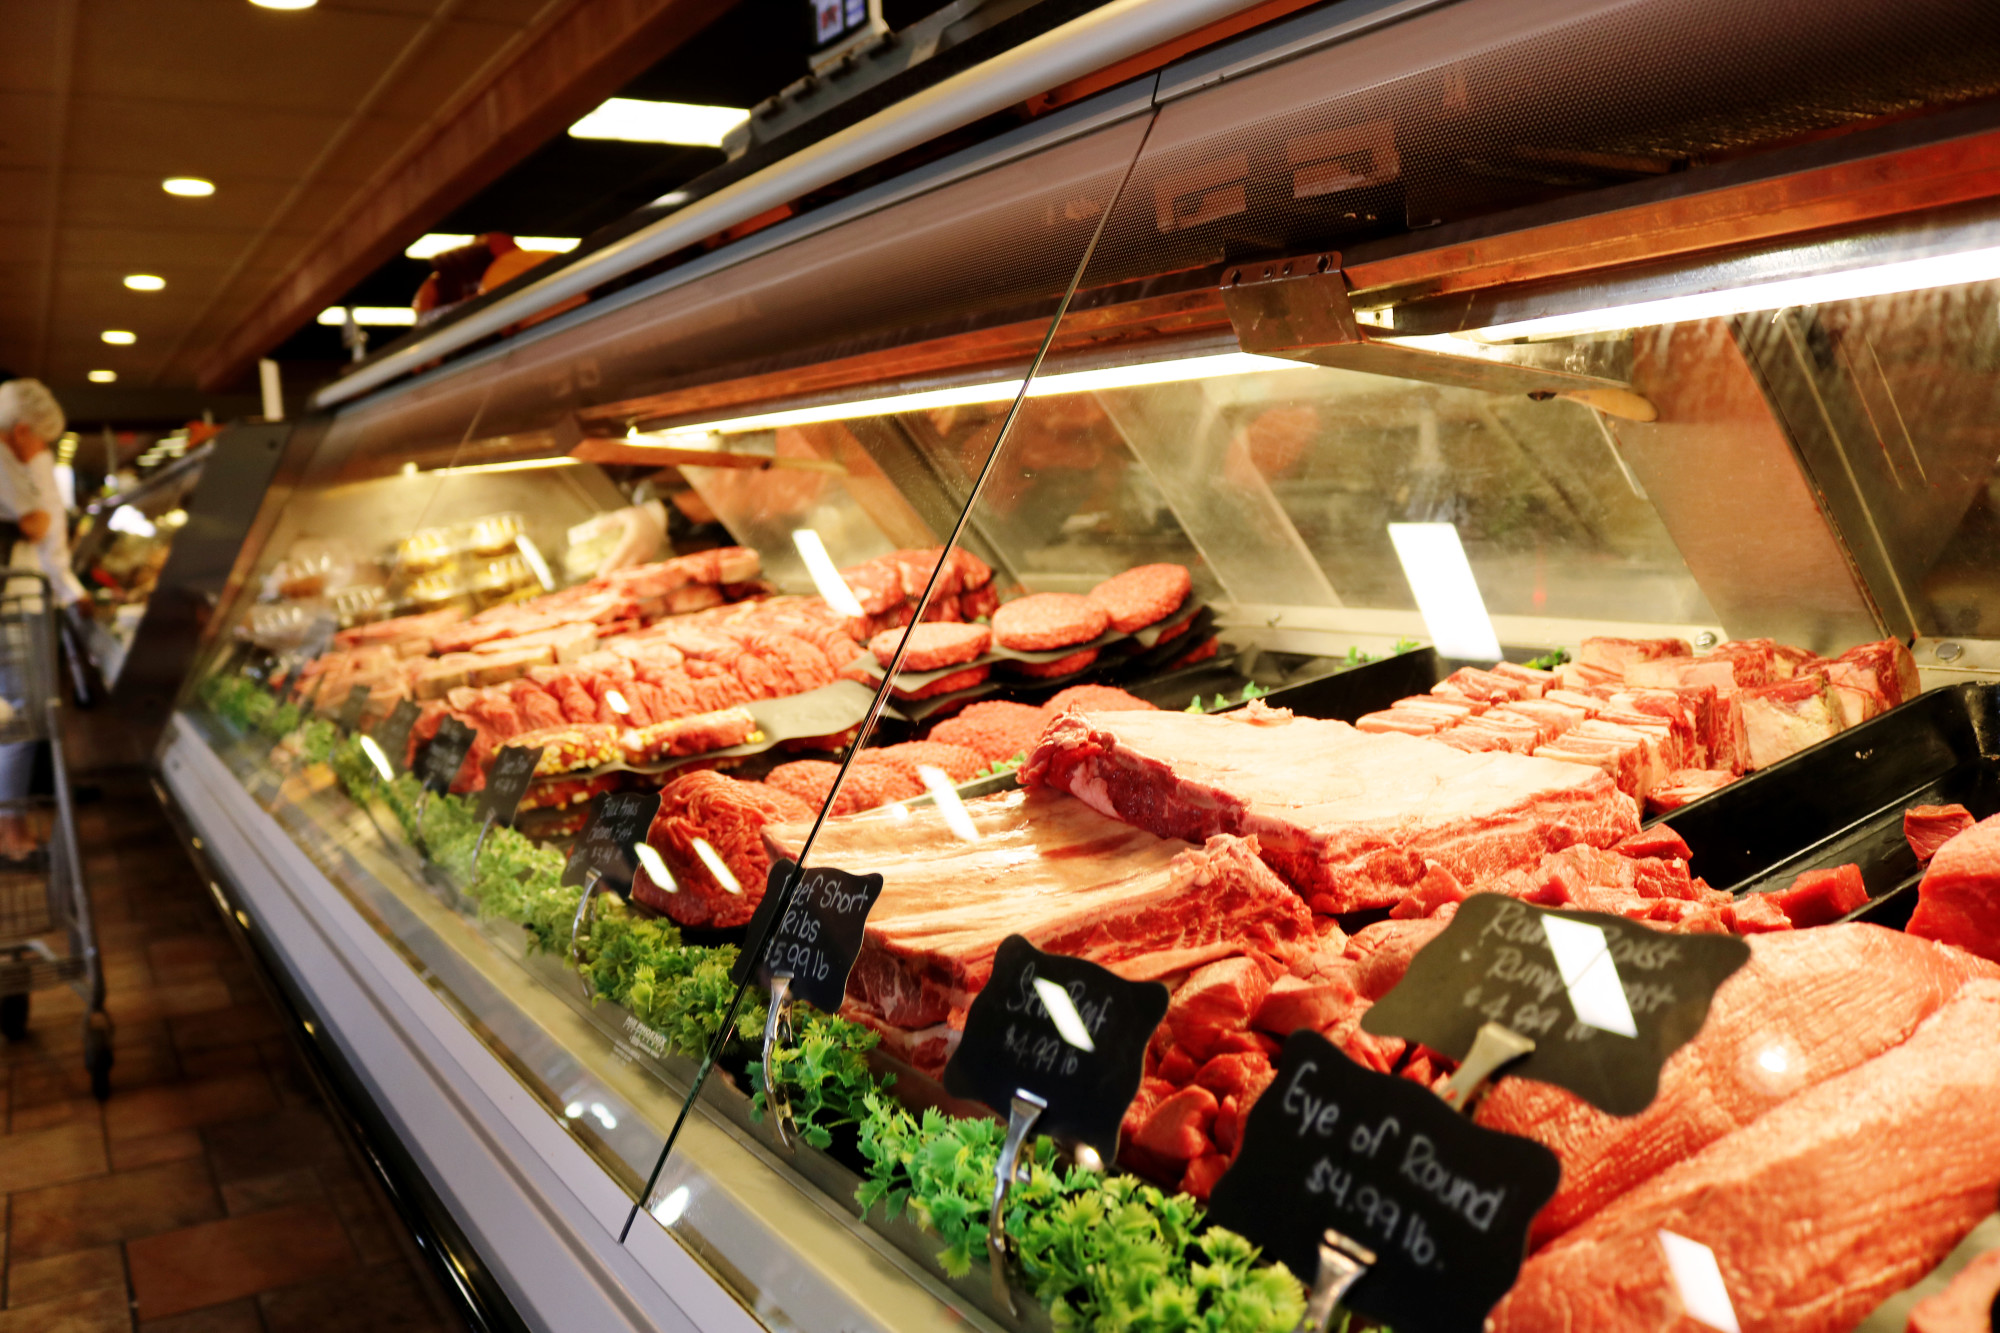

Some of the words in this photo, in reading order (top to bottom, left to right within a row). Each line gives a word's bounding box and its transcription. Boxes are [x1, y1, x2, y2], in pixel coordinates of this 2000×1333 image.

[820, 880, 869, 914] Short
[780, 909, 821, 943] Ribs
[812, 949, 830, 982] lb
[1284, 1061, 1340, 1136] Eye
[1351, 1116, 1400, 1157] of
[1401, 1135, 1505, 1232] Round
[1305, 1156, 1400, 1240] $4.99
